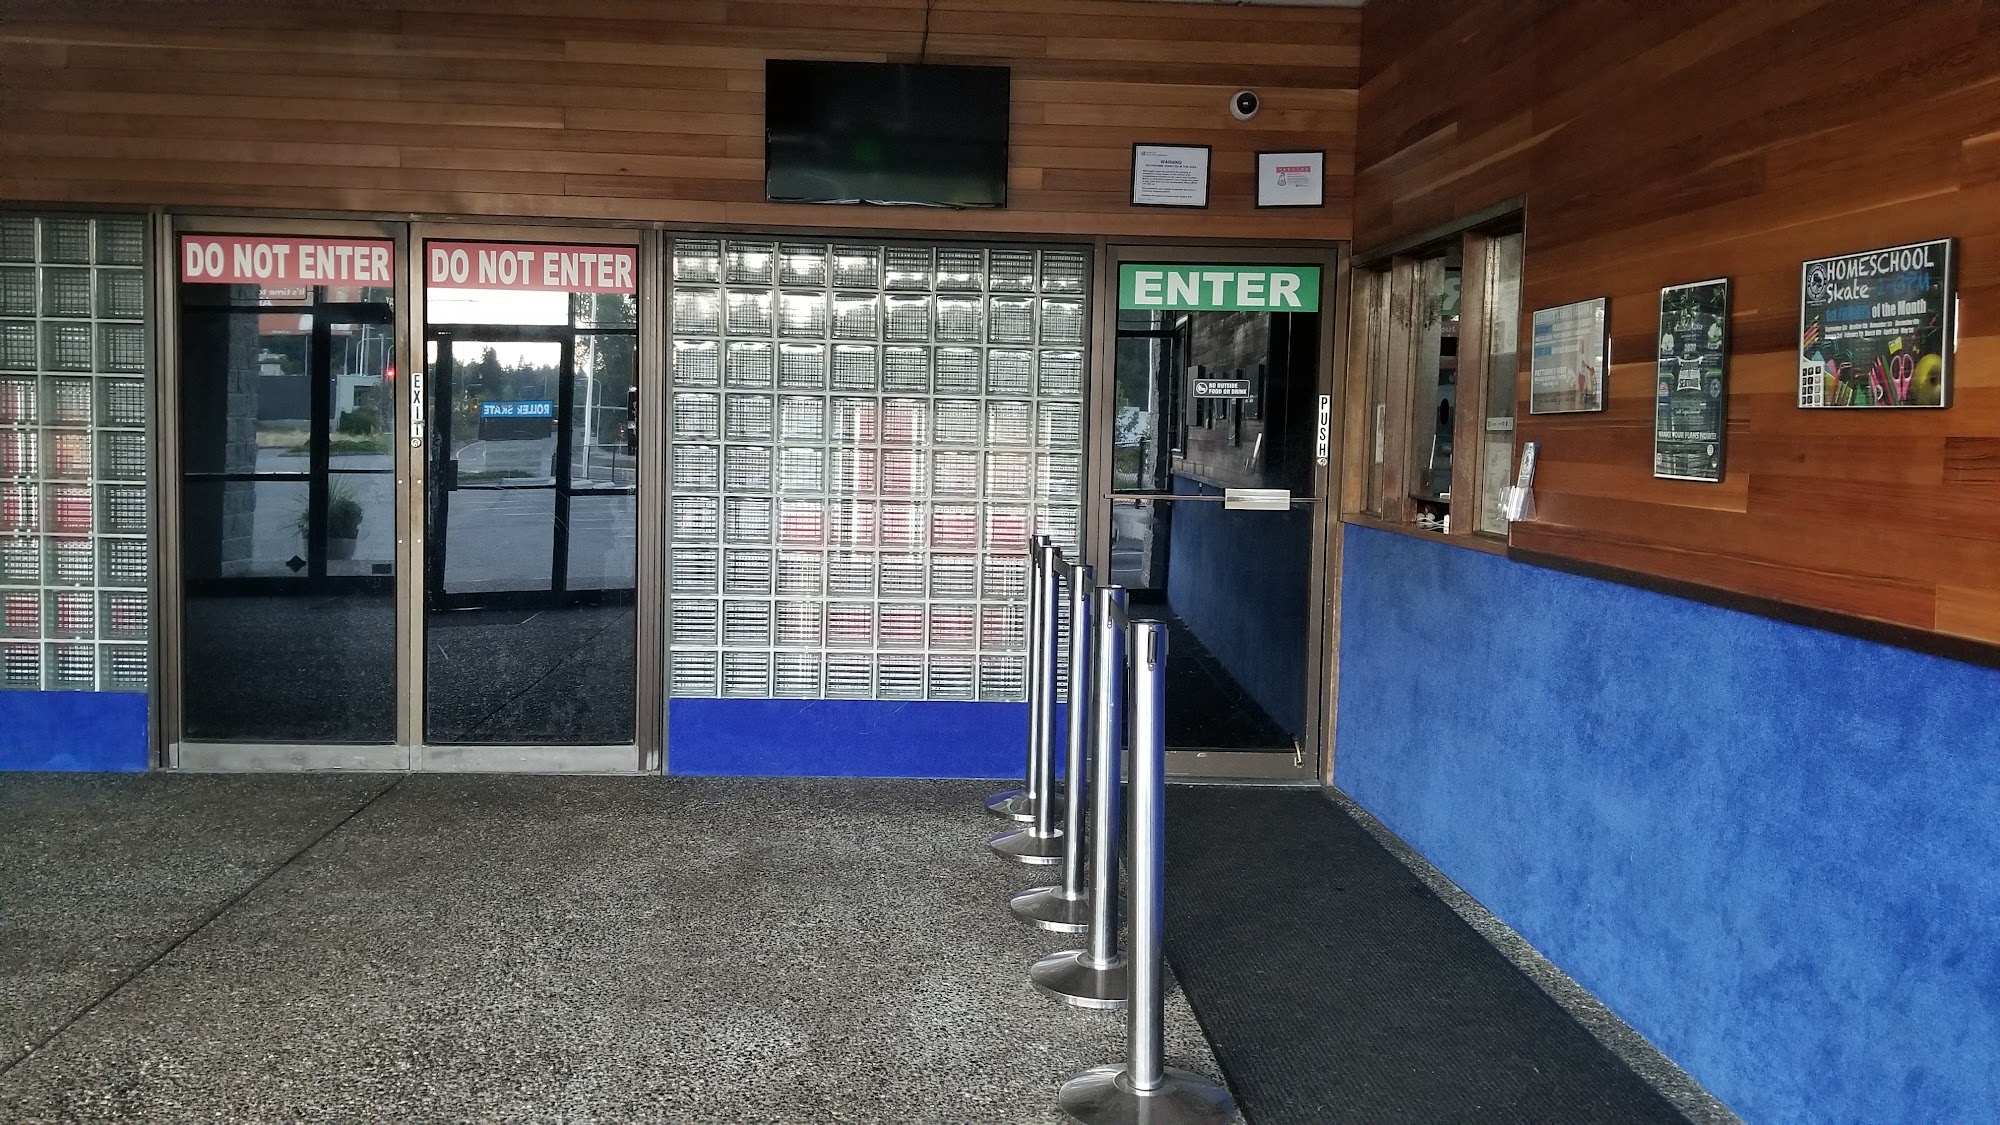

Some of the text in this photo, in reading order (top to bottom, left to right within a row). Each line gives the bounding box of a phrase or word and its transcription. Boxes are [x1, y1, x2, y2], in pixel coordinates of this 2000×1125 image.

[186, 242, 390, 282] DO NOT ENTER
[431, 247, 633, 288] DO NOT ENTER
[1826, 246, 1934, 282] HOMESCHOOL
[1134, 271, 1302, 307] ENTER
[1826, 279, 1870, 304] Skate
[1872, 303, 1881, 318] of
[1882, 302, 1896, 317] the
[1897, 298, 1927, 316] Month
[413, 374, 421, 436] EXIT
[1318, 397, 1329, 457] PUSH
